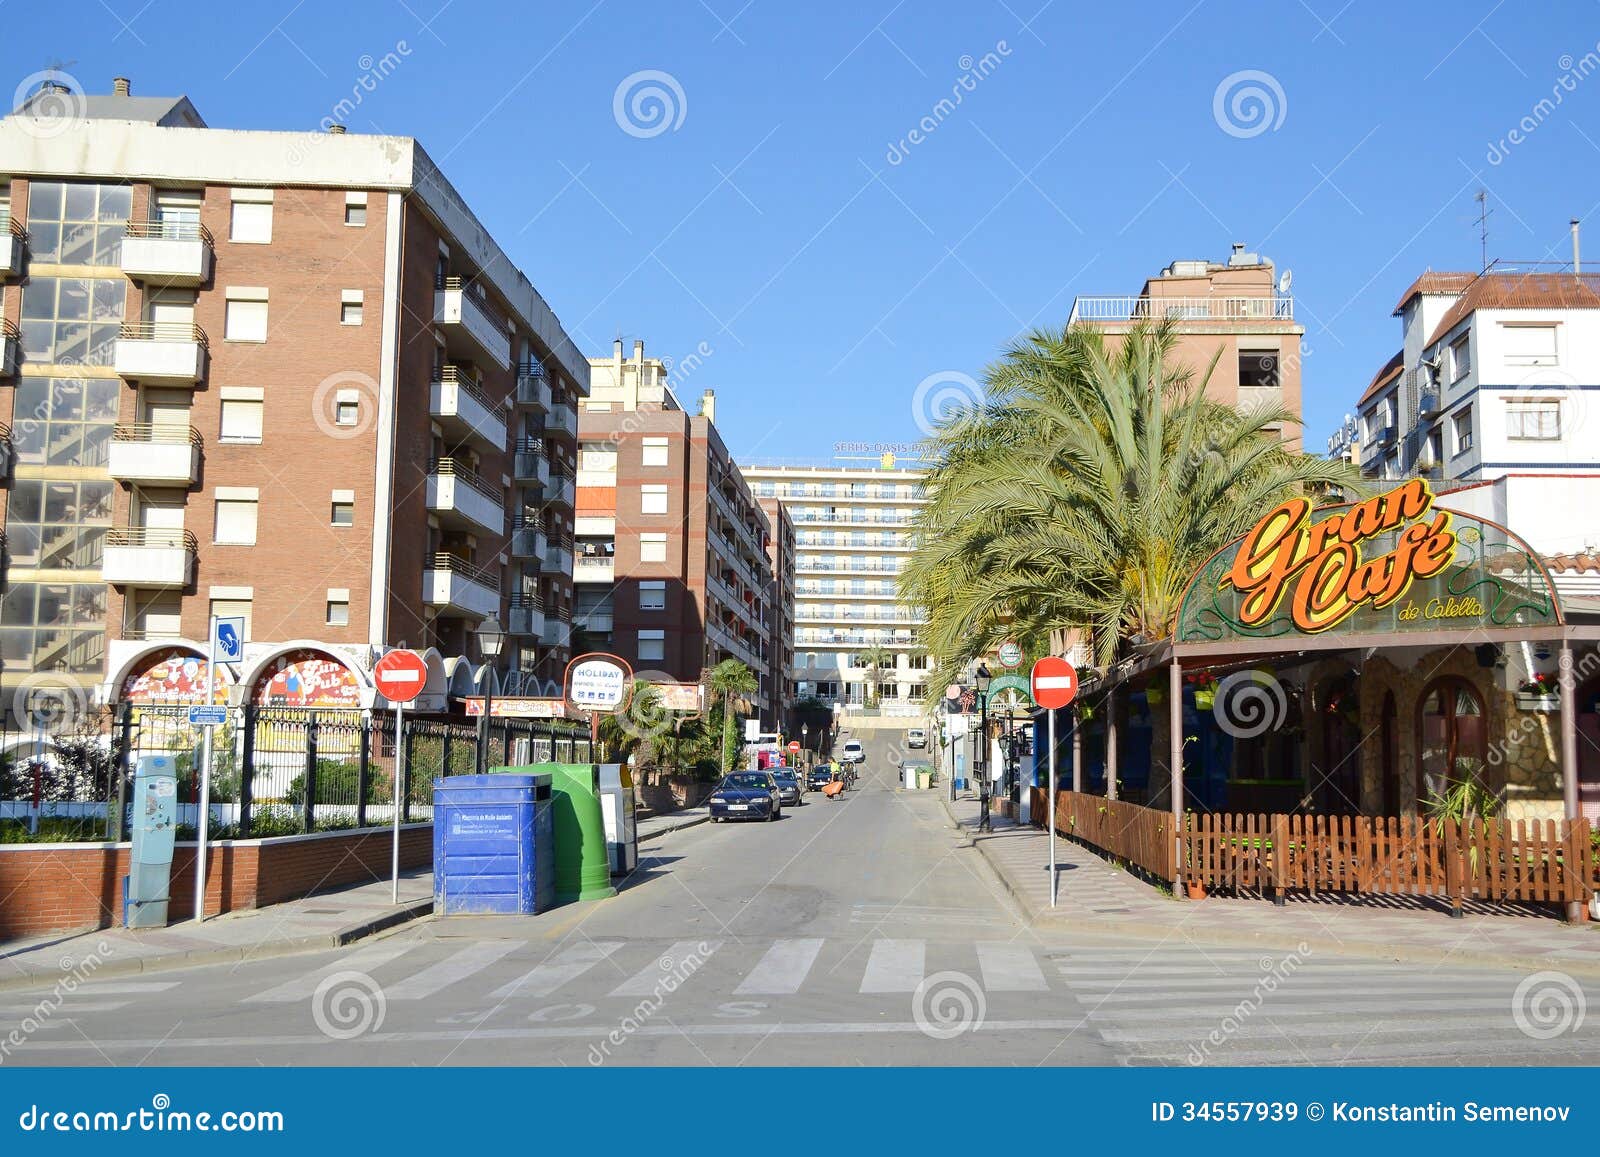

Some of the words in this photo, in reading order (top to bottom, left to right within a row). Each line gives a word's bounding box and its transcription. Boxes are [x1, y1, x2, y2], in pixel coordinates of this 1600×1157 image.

[1218, 476, 1436, 626] Gran
[1290, 509, 1459, 634] Café
[1398, 600, 1420, 621] de
[1424, 596, 1486, 620] Calella
[577, 668, 620, 679] HOLIDAY
